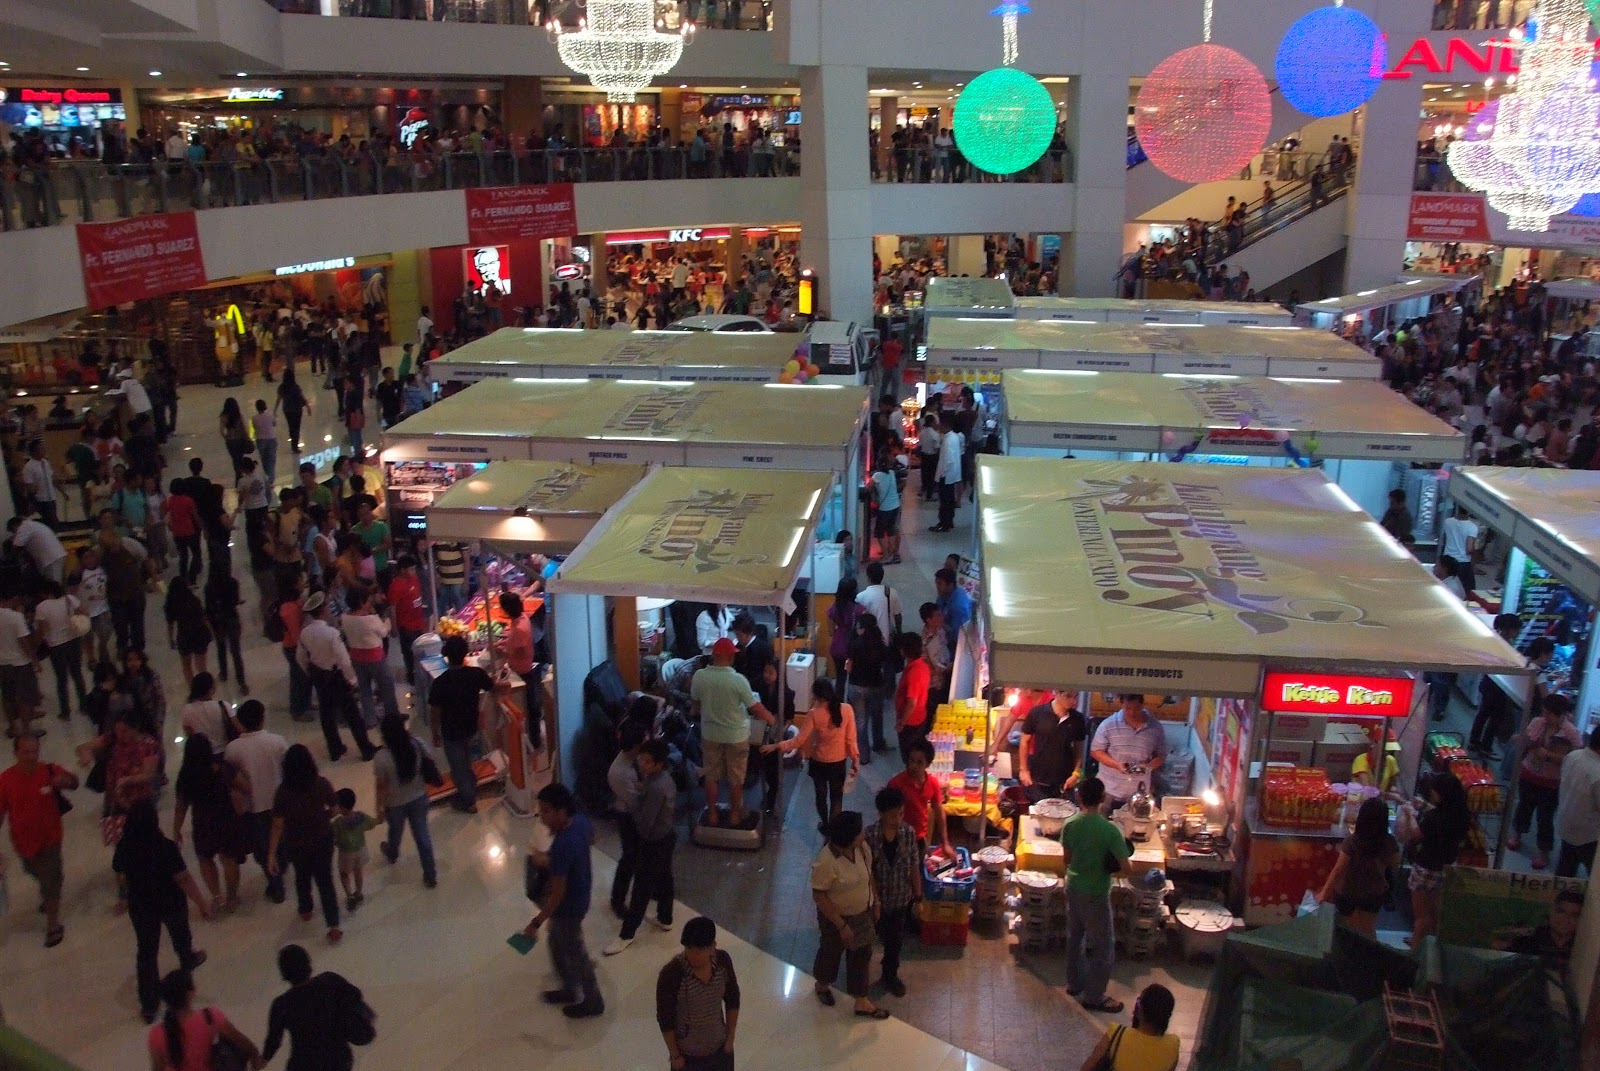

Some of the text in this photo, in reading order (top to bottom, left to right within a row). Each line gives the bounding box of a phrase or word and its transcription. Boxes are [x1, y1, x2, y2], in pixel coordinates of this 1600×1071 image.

[21, 89, 110, 104] Dairy Queen
[484, 204, 533, 218] FERNANDO
[1411, 196, 1480, 214] LANDMARK
[669, 229, 703, 242] KFC
[1100, 500, 1215, 619] Pinoy
[1103, 667, 1135, 677] UNIQUE
[1136, 668, 1184, 679] PRODUCTS
[1282, 683, 1393, 705] Kettle Korn
